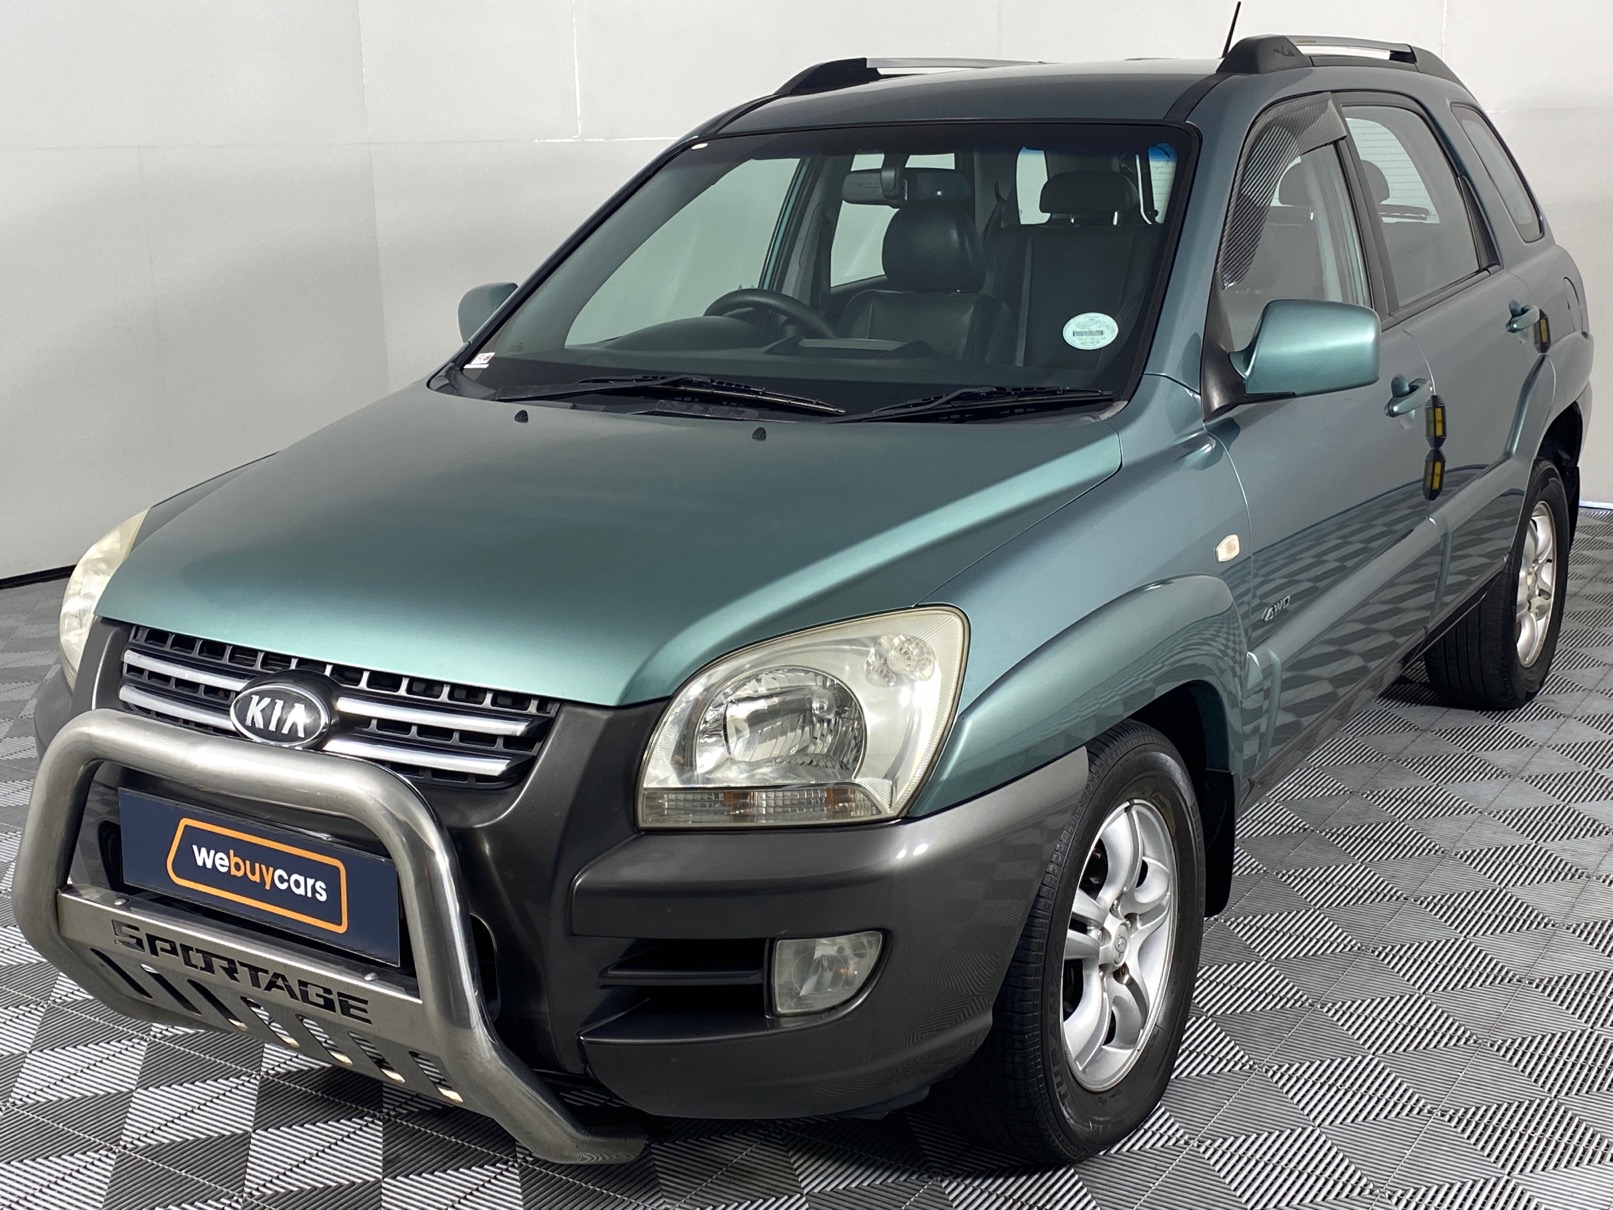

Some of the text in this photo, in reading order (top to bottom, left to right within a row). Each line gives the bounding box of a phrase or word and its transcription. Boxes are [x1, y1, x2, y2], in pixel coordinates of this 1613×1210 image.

[1261, 595, 1290, 621] 4WD
[245, 695, 306, 737] KIA
[193, 844, 327, 902] webuycars
[111, 918, 372, 1024] SPORTAGE
[1049, 937, 1068, 1104] TURANZA
